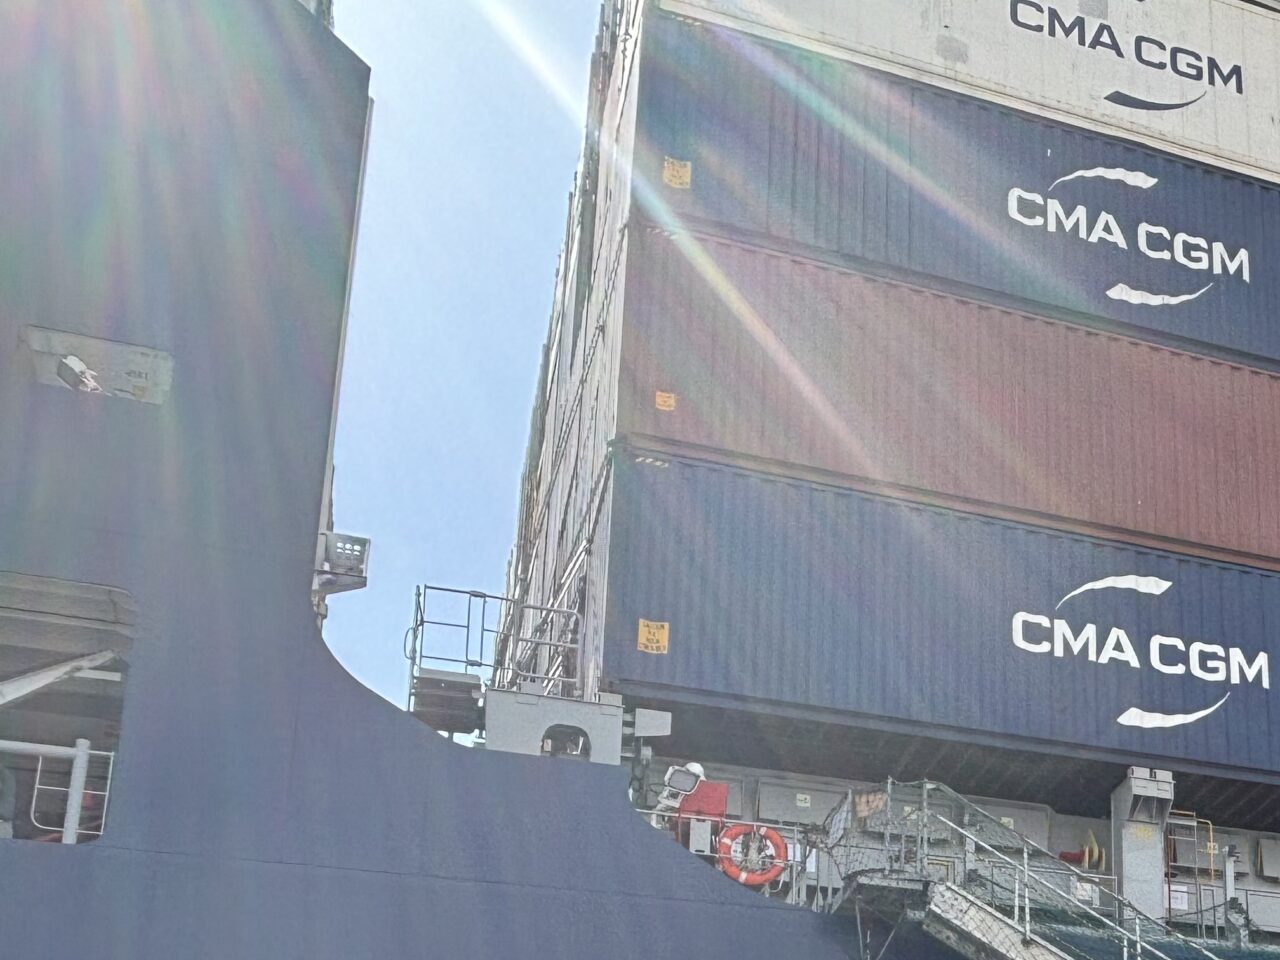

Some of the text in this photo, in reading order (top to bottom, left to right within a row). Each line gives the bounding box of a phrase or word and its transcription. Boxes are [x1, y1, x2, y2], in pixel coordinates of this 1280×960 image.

[1009, 0, 1244, 95] CMA CGM
[1007, 187, 1250, 283] CMA CGM
[1012, 611, 1270, 689] CMA CGM
